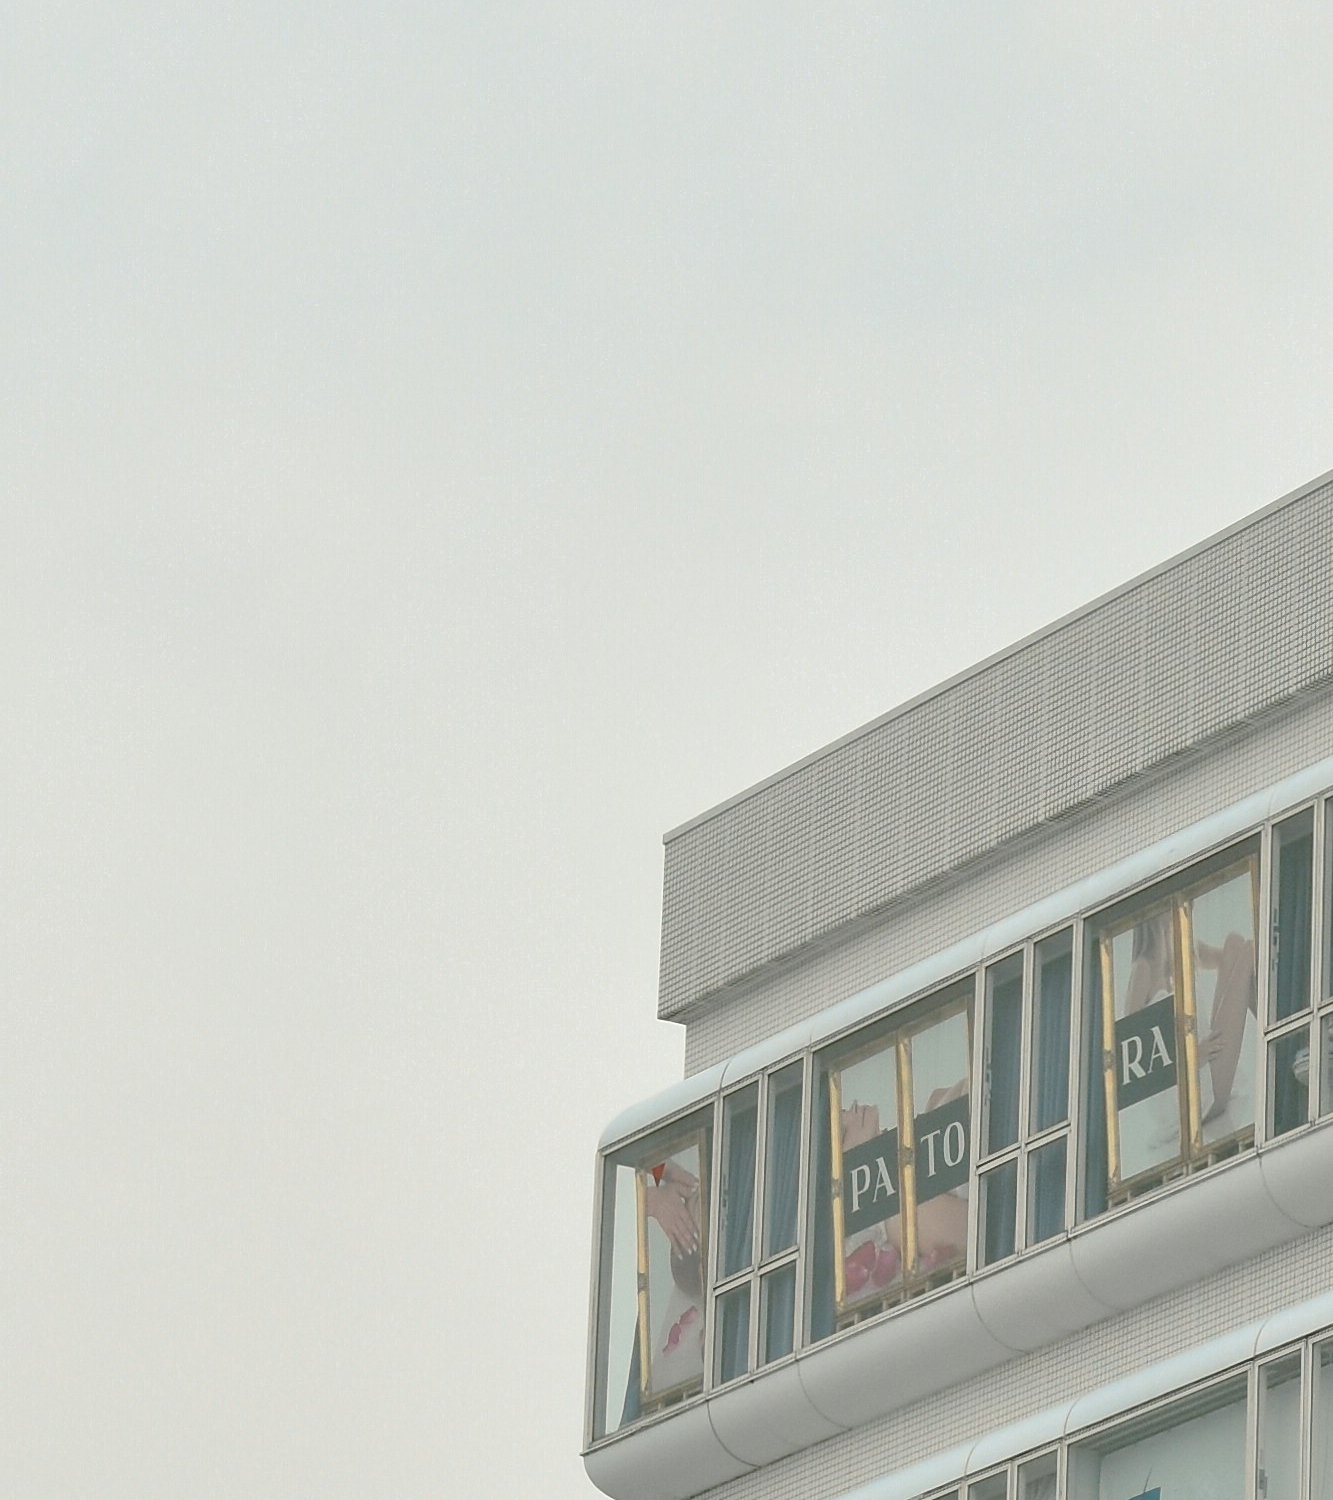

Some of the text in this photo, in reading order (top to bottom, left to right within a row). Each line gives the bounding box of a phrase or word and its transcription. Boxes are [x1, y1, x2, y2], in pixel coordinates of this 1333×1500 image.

[850, 1026, 1173, 1214] PA TO RA
